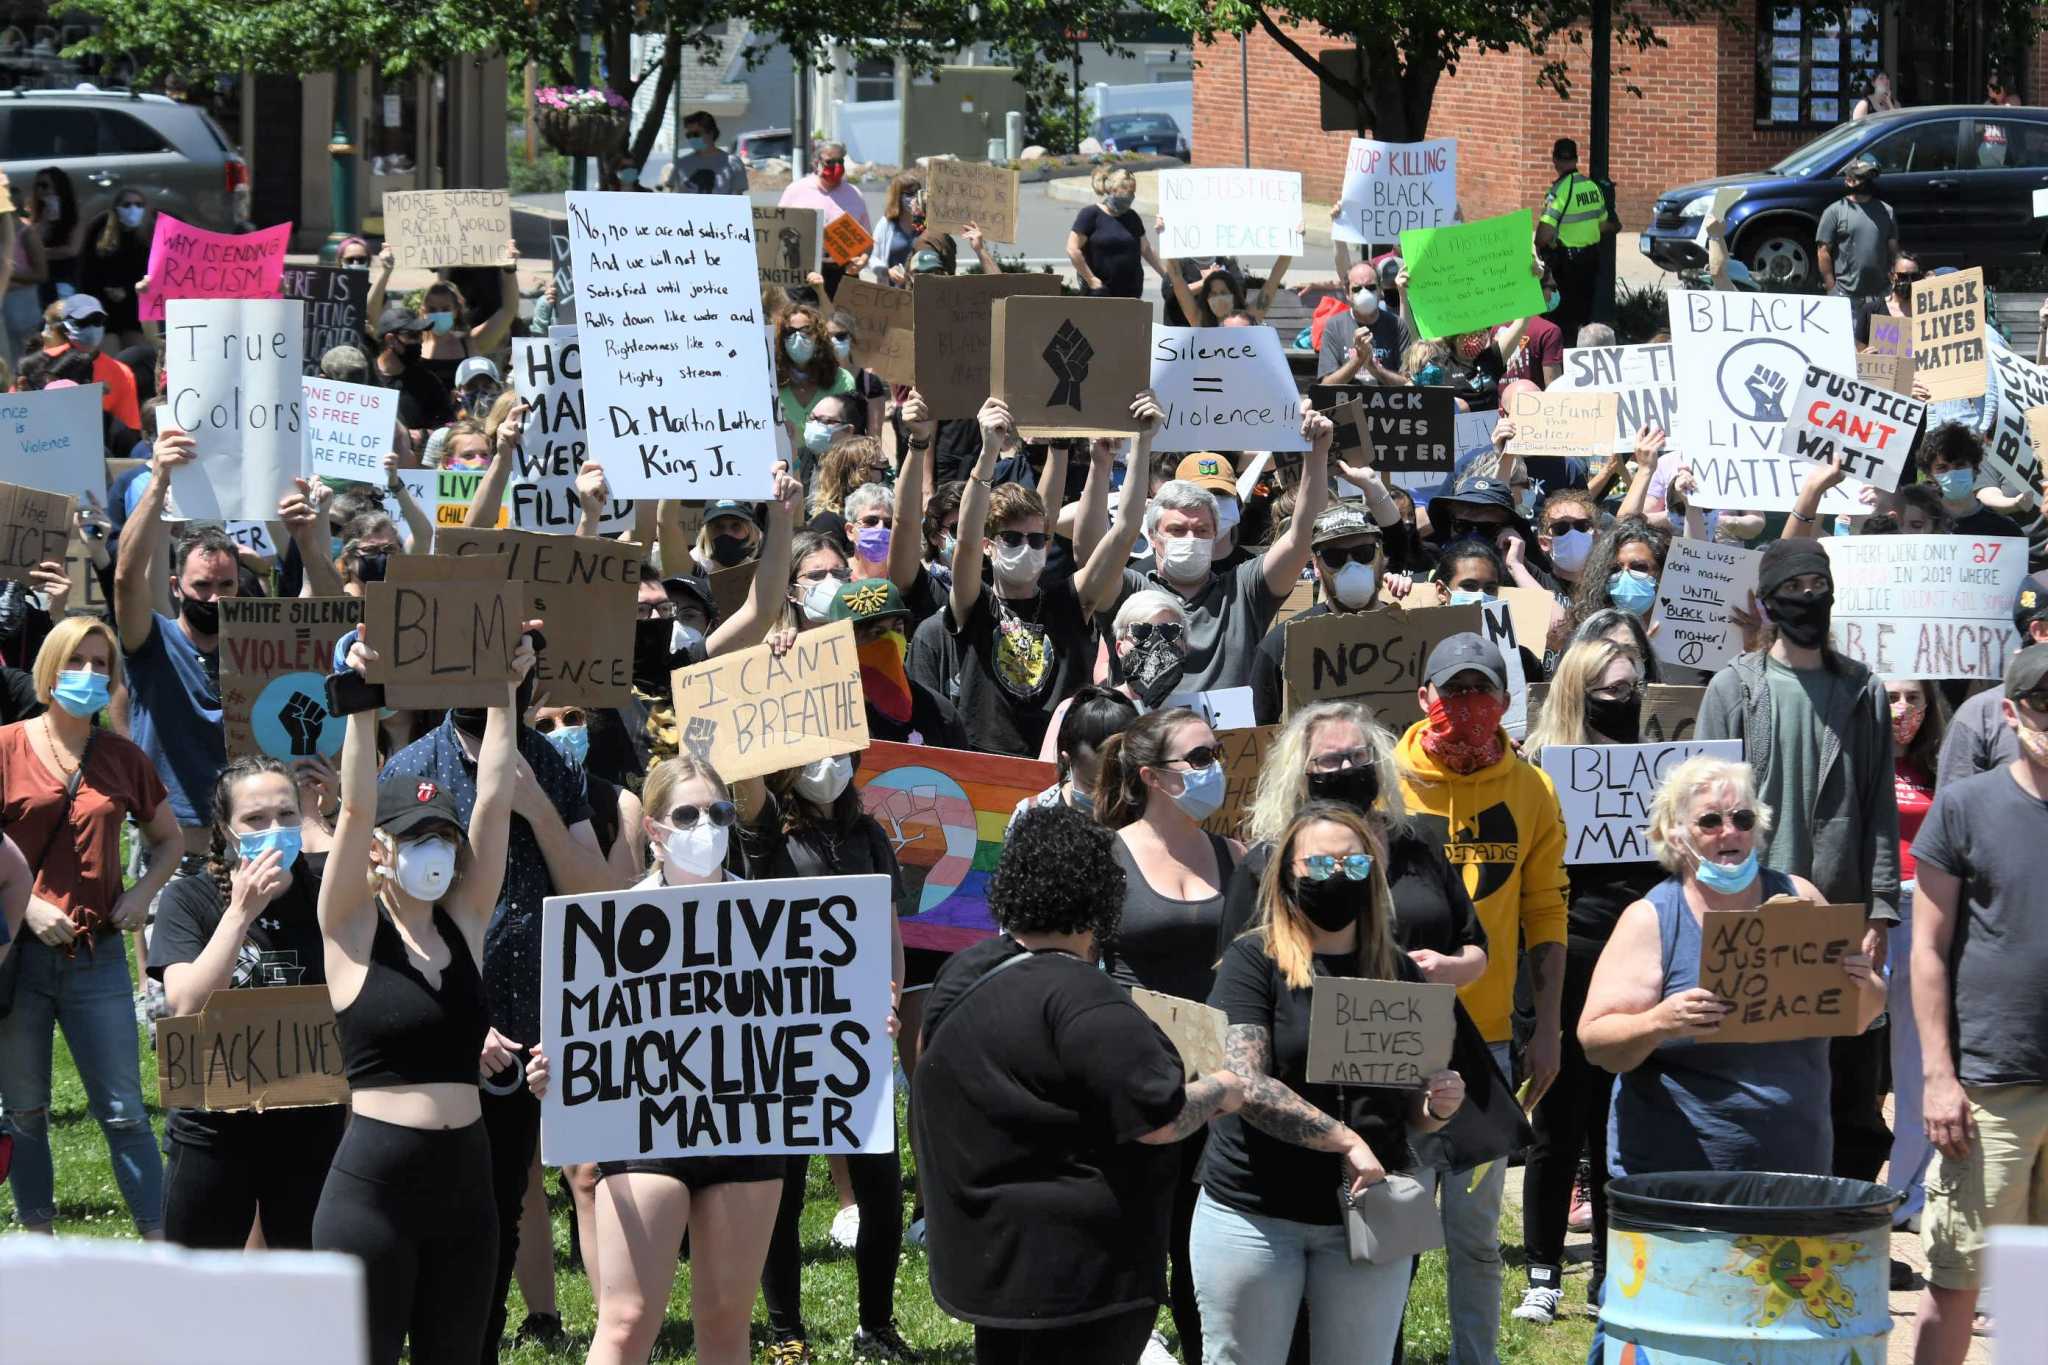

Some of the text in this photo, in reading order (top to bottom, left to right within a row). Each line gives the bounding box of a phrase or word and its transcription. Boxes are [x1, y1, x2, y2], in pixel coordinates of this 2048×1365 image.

[1389, 147, 1446, 176] KILLING
[387, 191, 503, 211] MORE SCARED
[1166, 176, 1194, 201] NO
[1374, 181, 1434, 207] BLACK
[1576, 190, 1600, 207] POLICE
[401, 217, 506, 237] RACIST WORLD
[608, 224, 628, 241] no
[635, 226, 649, 237] we
[655, 226, 673, 237] are
[677, 220, 694, 237] not
[1172, 223, 1280, 249] NO PEACE
[163, 230, 198, 258] WHY
[202, 243, 219, 263] IS
[404, 244, 506, 266] PANDEMIC
[590, 249, 721, 272] And we will not be
[163, 257, 263, 292] RACISM
[328, 271, 351, 301] IS
[656, 281, 680, 294] until
[1917, 280, 1978, 315] BLACK
[585, 309, 754, 328] Rolls down like water and
[1688, 293, 1830, 334] BLACK
[1920, 309, 1976, 342] LIVES
[175, 324, 288, 361] True
[686, 335, 704, 348] like
[1155, 336, 1256, 361] Silence
[1915, 337, 1984, 372] MATTER
[619, 369, 663, 387] Mighty
[1569, 347, 1625, 387] SAY
[1857, 362, 1895, 376] STICE
[336, 392, 355, 406] OF
[361, 395, 380, 409] US
[1517, 393, 1602, 418] Defund
[1806, 365, 1922, 427] JUSTICE
[174, 386, 300, 433] Colors
[322, 408, 360, 425] FREE
[648, 405, 714, 432] Martin
[1996, 354, 2025, 467] BLACK
[1367, 416, 1428, 436] IVES
[1709, 419, 1785, 451] LIV
[1807, 400, 1896, 449] CAN'T
[19, 435, 71, 454] Violence
[328, 430, 355, 446] ALL
[360, 435, 381, 449] OF
[1375, 443, 1446, 461] TTER
[338, 450, 377, 468] FREE
[639, 444, 697, 483] King
[1796, 430, 1884, 480] WAIT
[1887, 543, 1919, 563] WERE
[1924, 543, 1958, 562] ONLY
[1972, 543, 2002, 563] 27
[1698, 569, 1734, 582] matter
[1893, 566, 1912, 583] IN
[1921, 566, 1953, 584] 2019
[1959, 567, 2001, 586] WHERE
[1682, 585, 1725, 603] UNTIL
[1840, 587, 1891, 612] POLICE
[223, 601, 365, 624] WHITE SILENC
[1666, 604, 1702, 619] BLACK
[394, 587, 510, 677] BLM
[228, 637, 334, 676] VIOLEN
[1847, 622, 2013, 678] BE ANGRY
[562, 894, 858, 982] NO LIVES
[1711, 917, 1765, 949] NO
[1706, 938, 1849, 974] JUSTICE
[1712, 972, 1769, 999] NO
[560, 966, 852, 1037] MATTER UNTIL
[1335, 992, 1423, 1026] BLACK
[166, 1018, 346, 1094] BLACK LIVES
[1343, 1030, 1424, 1057] LIVES
[562, 1019, 871, 1106] BLACK LIVES
[1331, 1060, 1423, 1083] MATTER
[639, 1093, 861, 1153] MATTER
